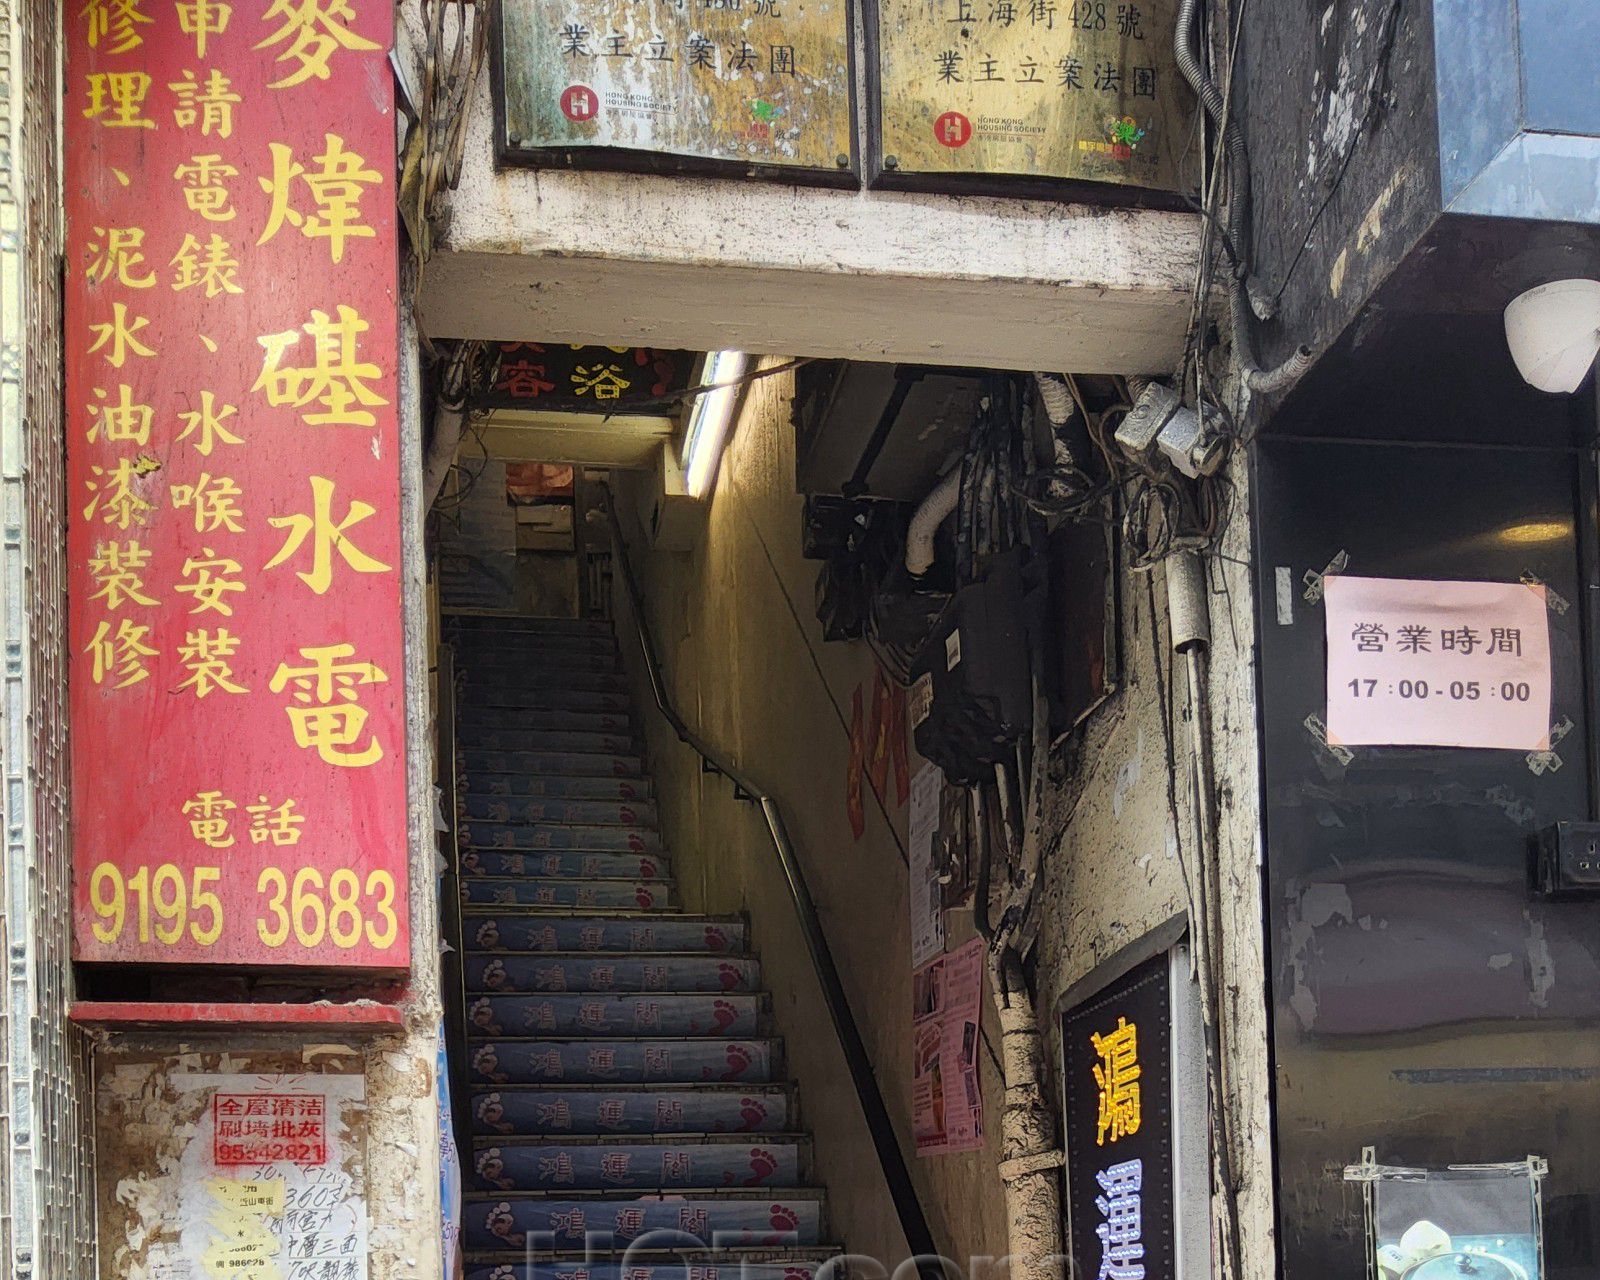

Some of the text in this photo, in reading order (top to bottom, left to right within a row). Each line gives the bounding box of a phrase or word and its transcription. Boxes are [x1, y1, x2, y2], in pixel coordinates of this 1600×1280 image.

[558, 23, 796, 77] 業主立案法團
[934, 50, 1156, 100] 業主立案法團
[1351, 622, 1523, 657] 營業時間
[181, 791, 306, 848] 電話
[90, 861, 398, 949] 9195 3683
[219, 1098, 322, 1117] 全屋清洁
[539, 1151, 694, 1185] 鴻運閣
[550, 1205, 709, 1241] 鴻運閣
